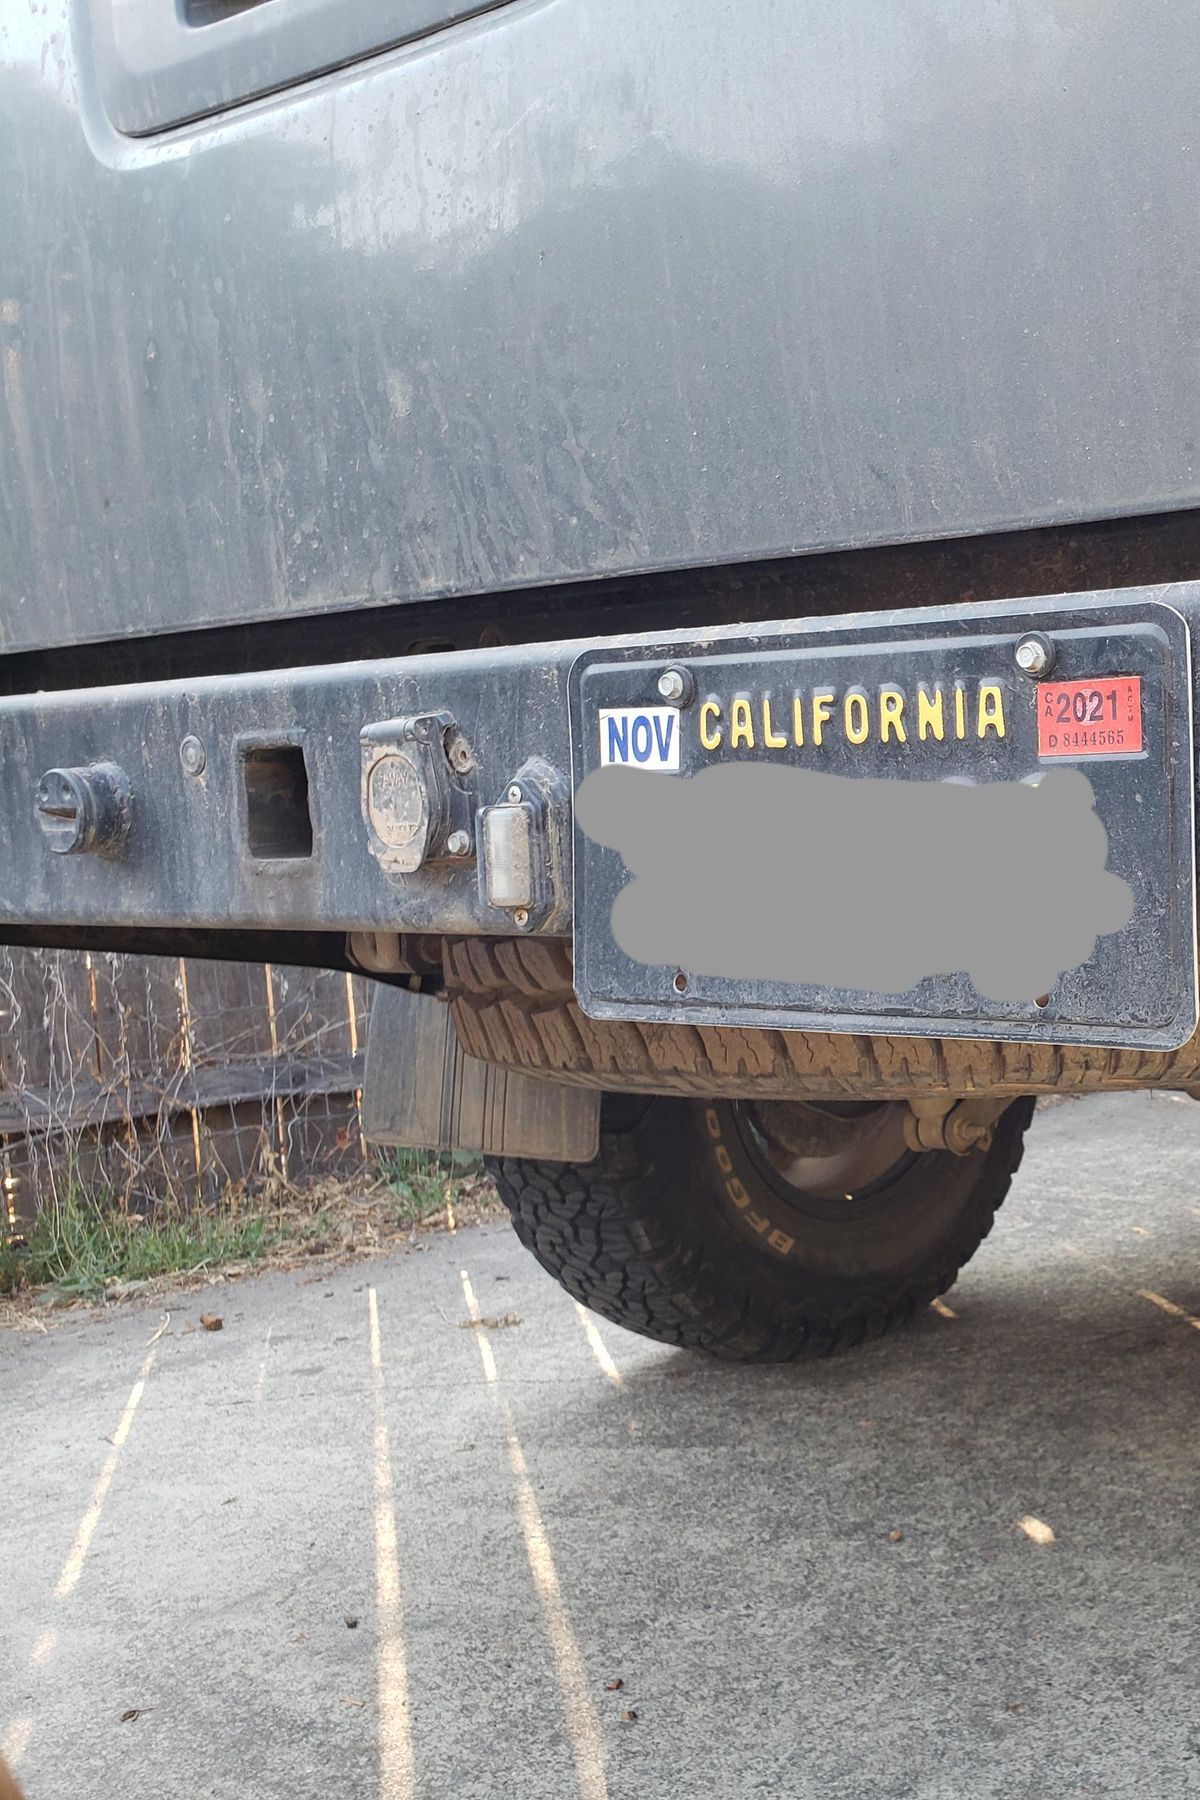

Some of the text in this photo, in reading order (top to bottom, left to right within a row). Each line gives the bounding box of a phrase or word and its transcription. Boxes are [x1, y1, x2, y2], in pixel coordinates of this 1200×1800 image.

[699, 685, 1006, 750] CALIFORNIA
[1056, 689, 1118, 723] 2021
[607, 714, 675, 763] NOV
[1063, 729, 1124, 747] 8444565
